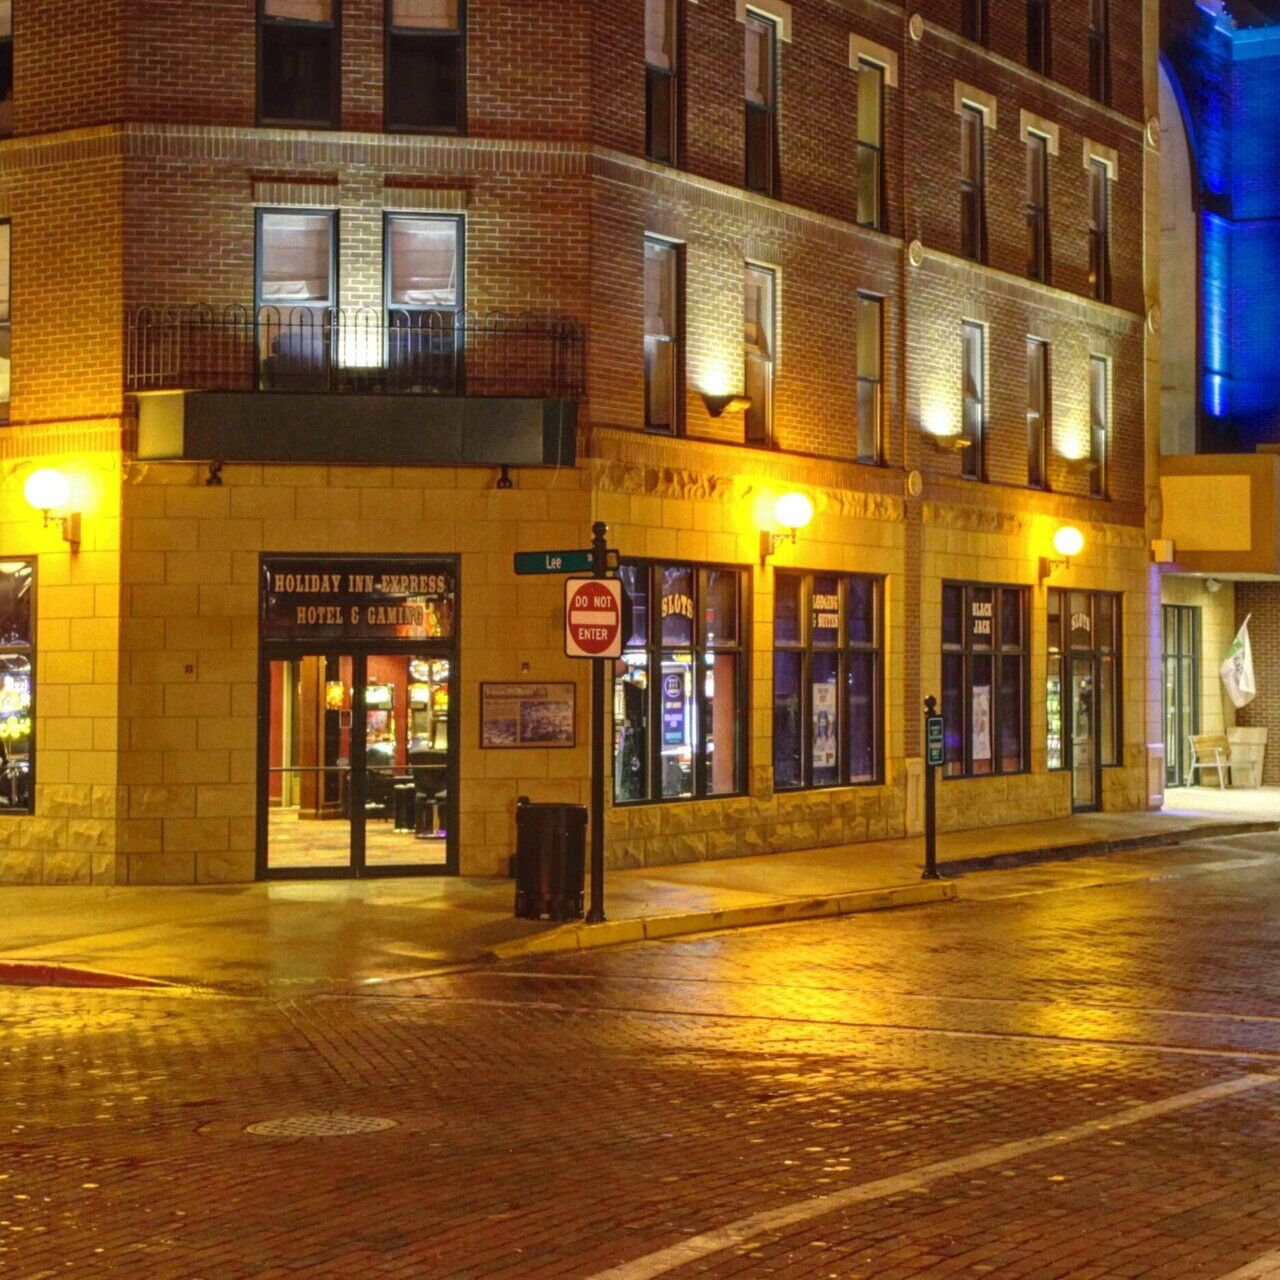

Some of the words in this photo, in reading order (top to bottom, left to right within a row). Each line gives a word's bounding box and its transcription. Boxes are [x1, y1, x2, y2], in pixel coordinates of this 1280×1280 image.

[546, 555, 562, 569] Lee
[274, 574, 341, 592] HOLIDAY
[349, 575, 374, 593] INN
[381, 575, 445, 593] EXPRESS
[575, 596, 588, 607] DO
[594, 596, 611, 607] NOT
[661, 594, 693, 619] SLOTS
[297, 606, 343, 624] HOTEL
[351, 606, 360, 624] &
[367, 606, 424, 625] GAMING
[972, 602, 992, 616] BLACK
[973, 620, 991, 634] JACK
[1071, 613, 1090, 632] SLOTS
[578, 628, 608, 640] ENTER
